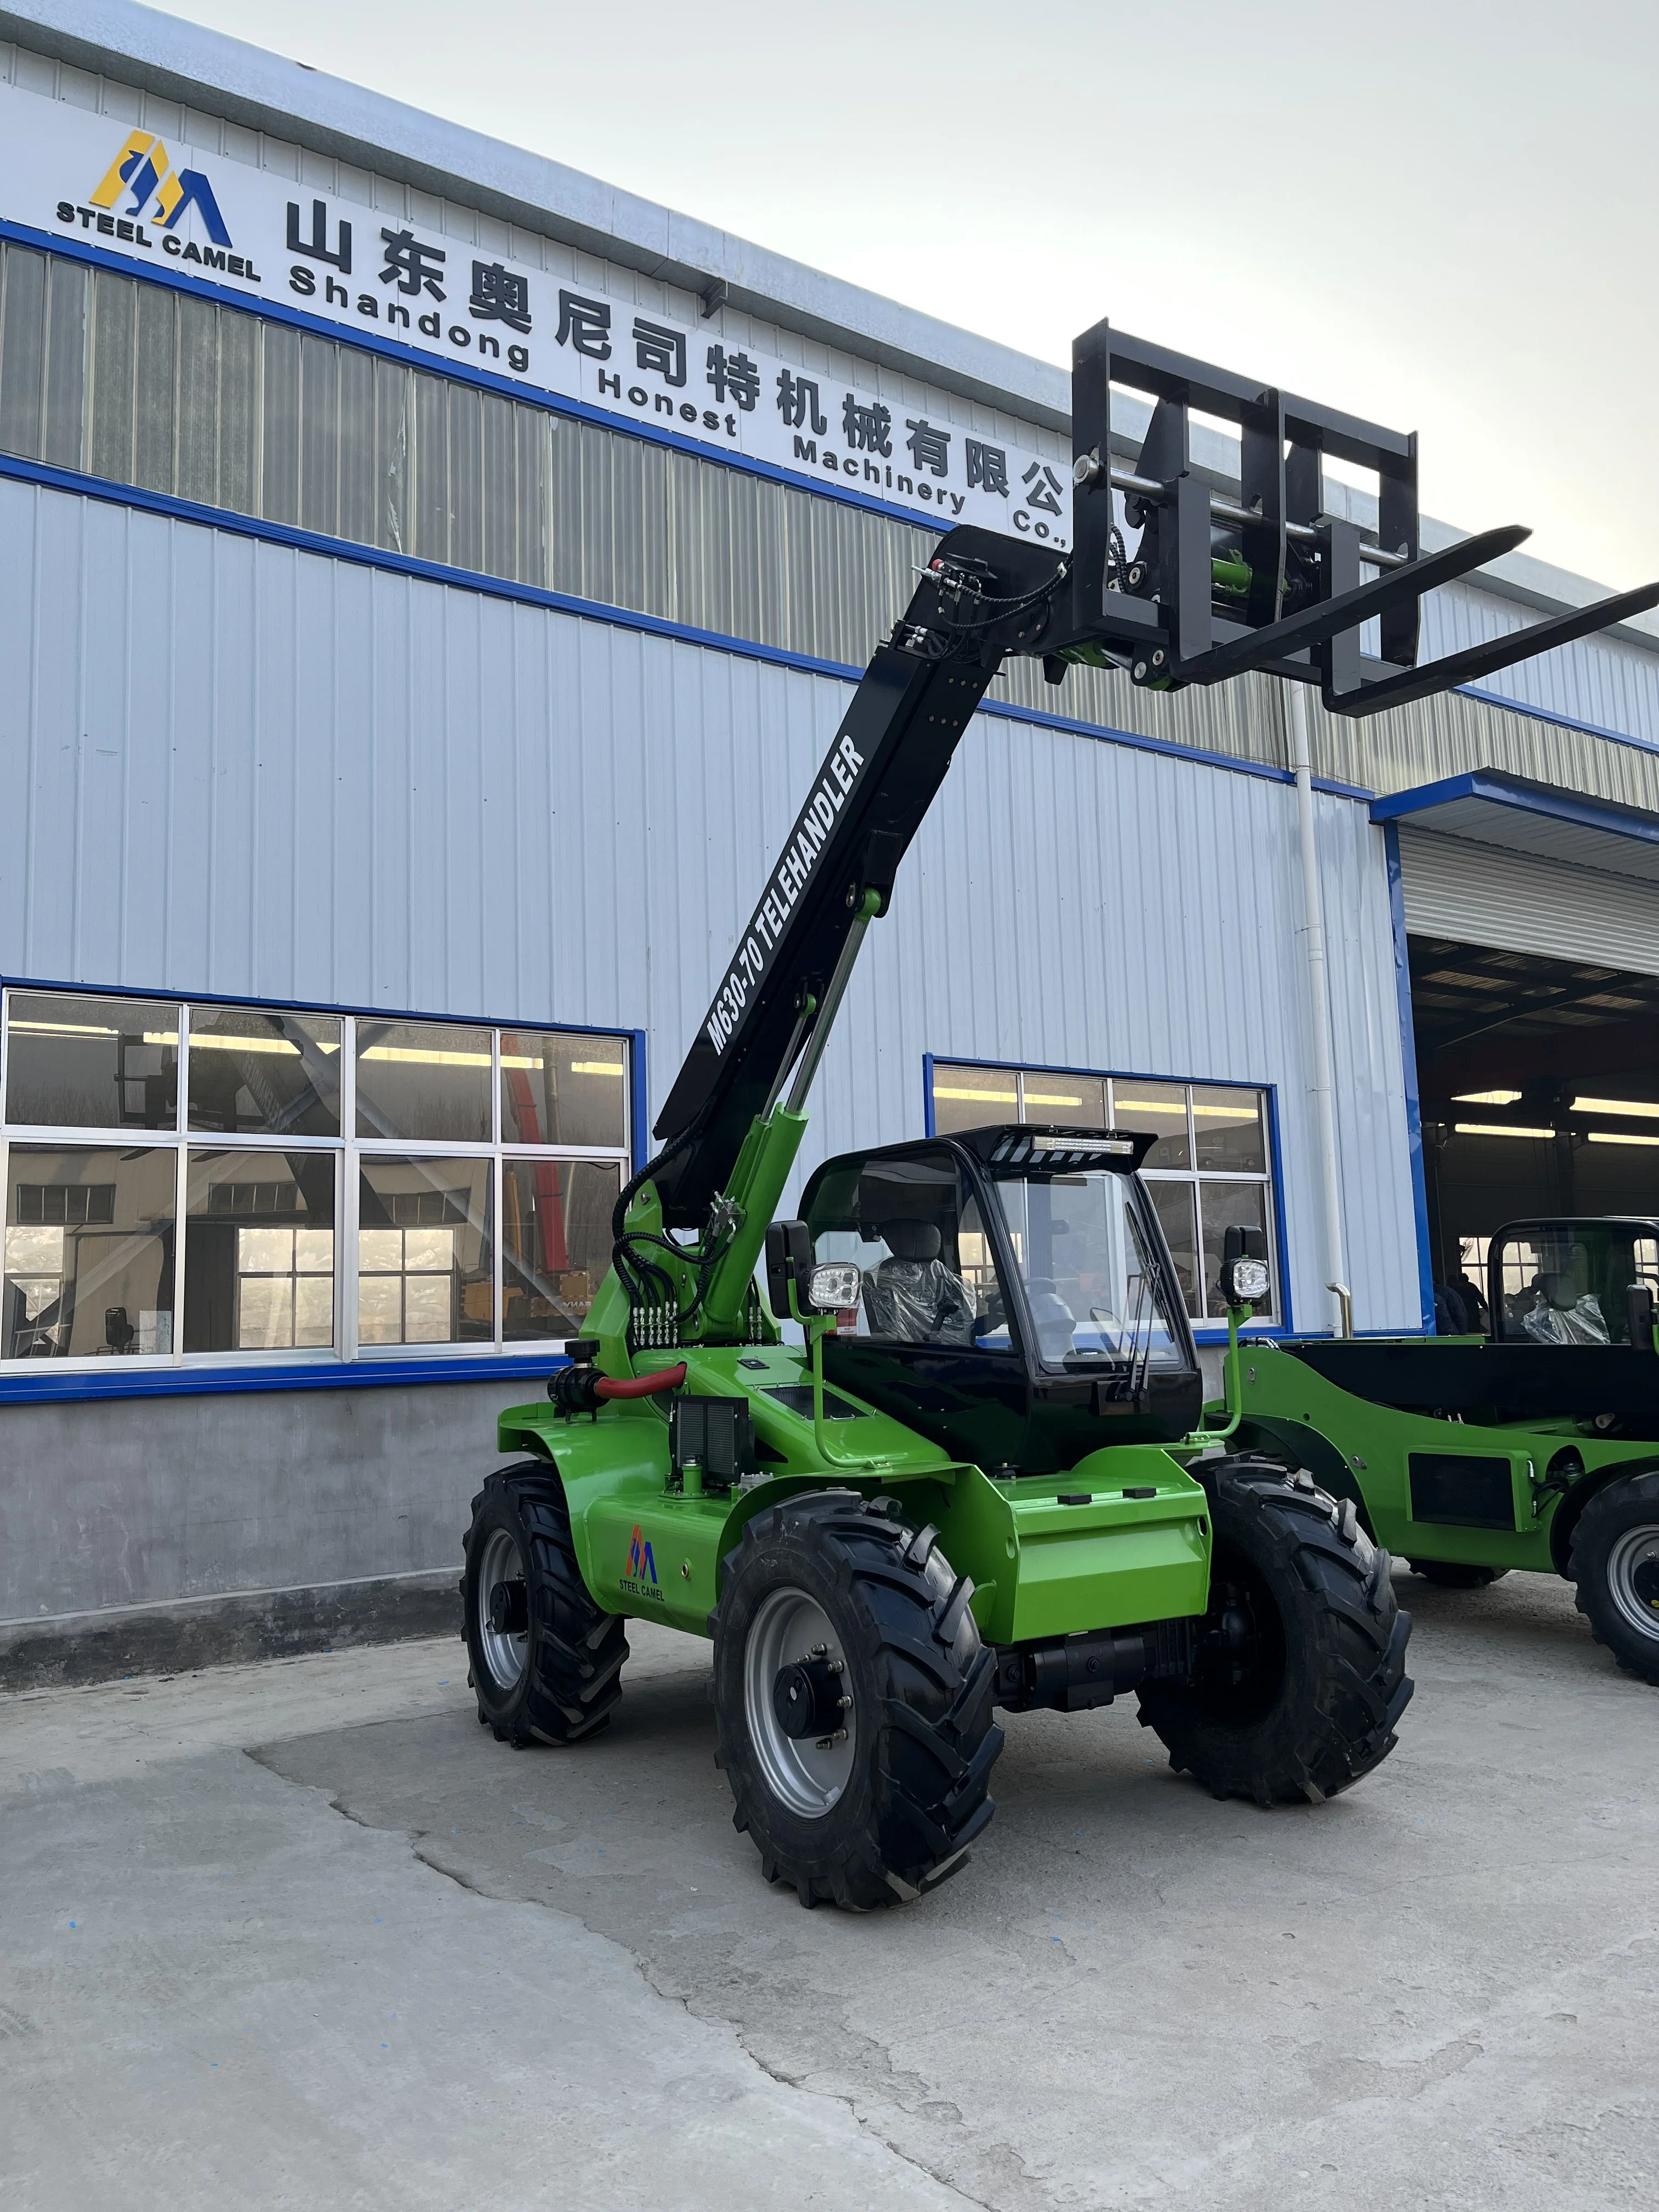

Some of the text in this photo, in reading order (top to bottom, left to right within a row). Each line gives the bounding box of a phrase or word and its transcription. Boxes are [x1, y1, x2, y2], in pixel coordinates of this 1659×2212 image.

[57, 201, 261, 282] STEEL CAMEL
[289, 264, 1066, 548] Shandong Honest Machinery Co.,
[706, 734, 865, 1056] M630-70 TELEHANDLER
[619, 1578, 665, 1602] STEEL CAMEL
